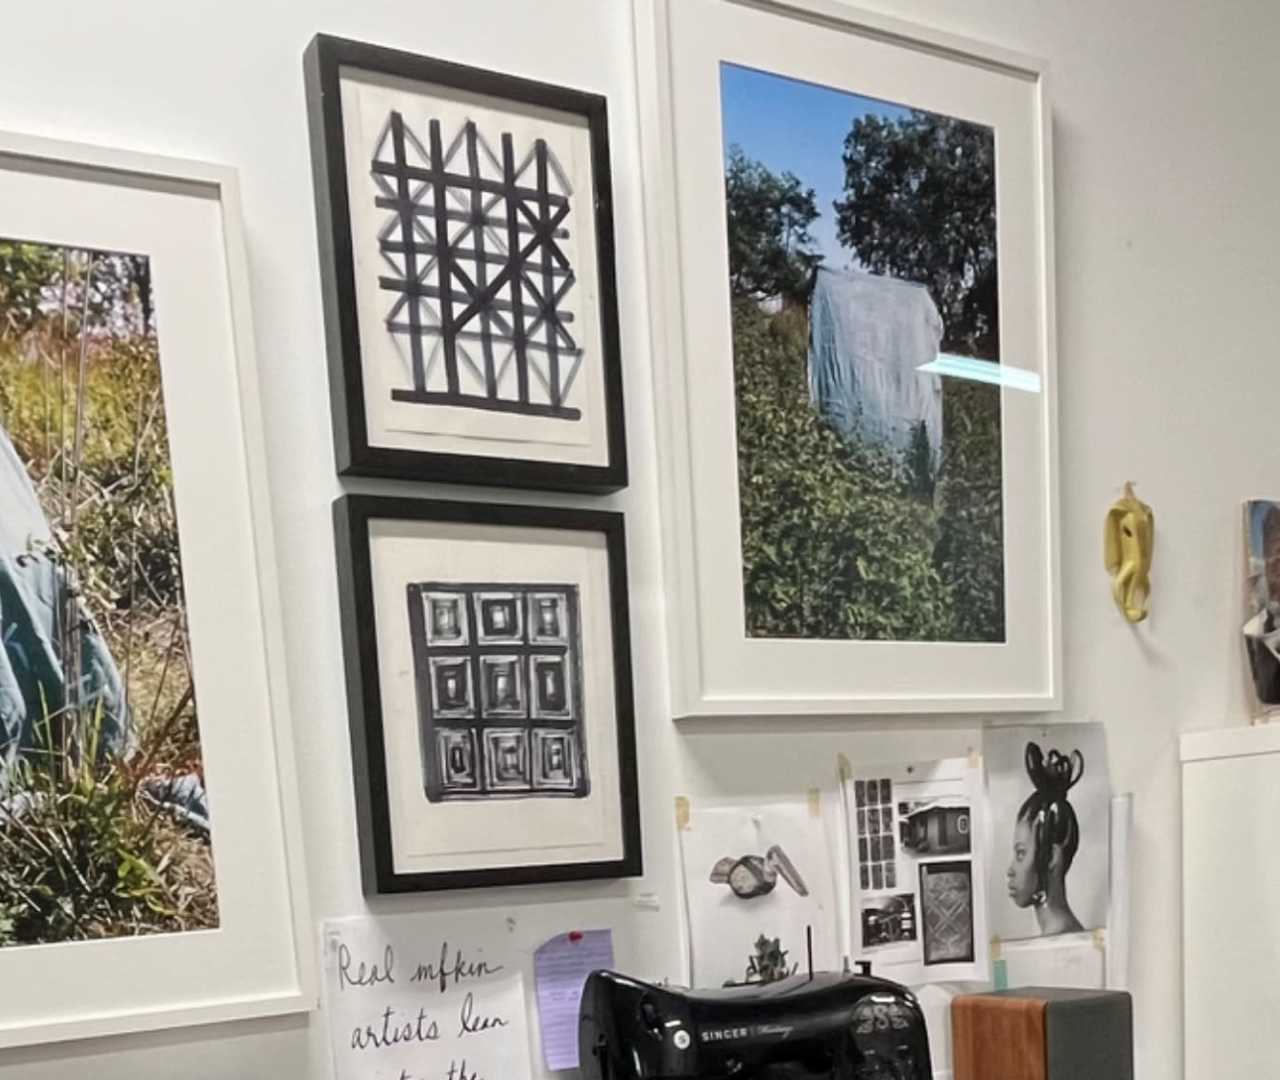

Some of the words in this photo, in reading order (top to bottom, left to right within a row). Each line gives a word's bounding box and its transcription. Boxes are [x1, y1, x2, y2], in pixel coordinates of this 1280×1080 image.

[338, 943, 395, 990] Real
[410, 942, 503, 992] mfkin
[351, 1001, 440, 1050] artists
[458, 992, 509, 1037] lean
[701, 1027, 747, 1042] SINGER
